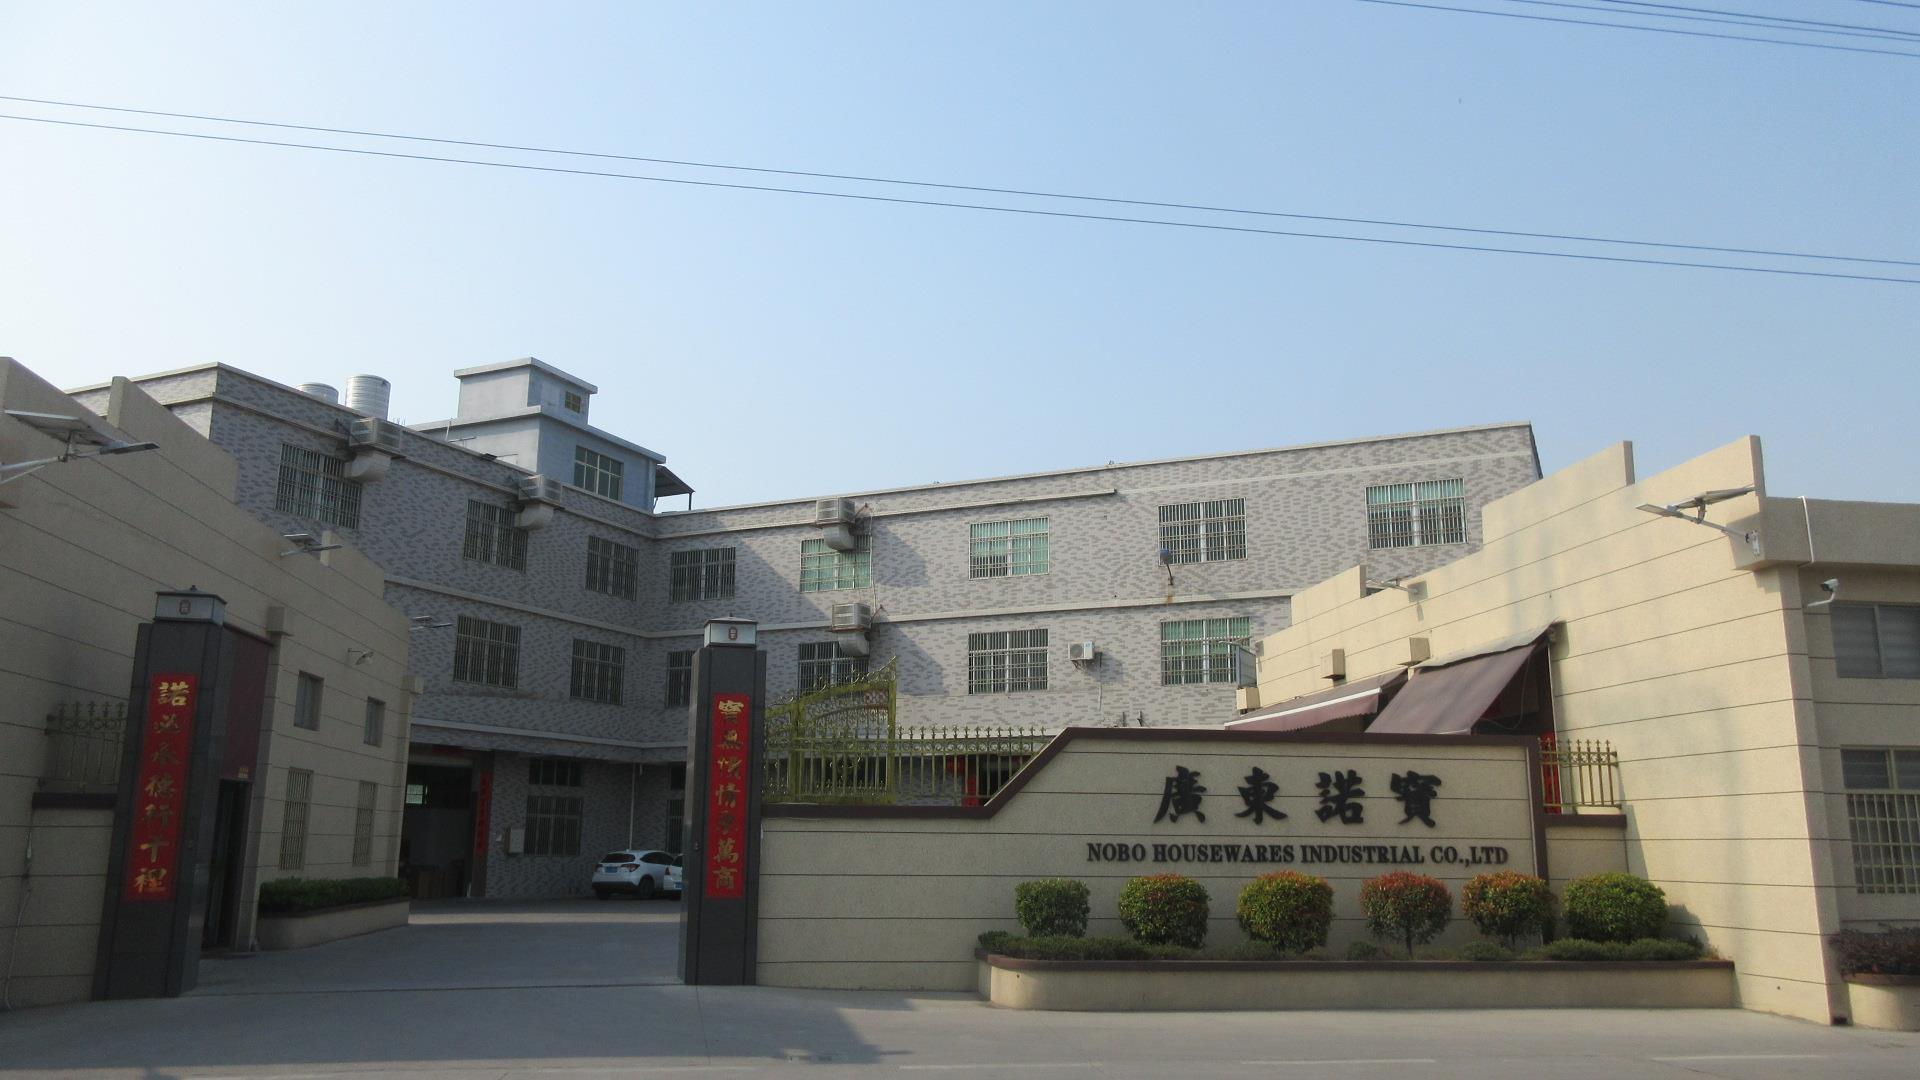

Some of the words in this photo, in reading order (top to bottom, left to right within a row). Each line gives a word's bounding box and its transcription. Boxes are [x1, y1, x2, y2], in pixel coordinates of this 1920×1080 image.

[1153, 765, 1442, 828] 廣東諾寶
[1088, 842, 1147, 863] NOBO
[1152, 843, 1295, 864] HOUSEWARES
[1300, 844, 1425, 865] INDUSTRIAL
[1430, 845, 1509, 868] CO.,LTD
